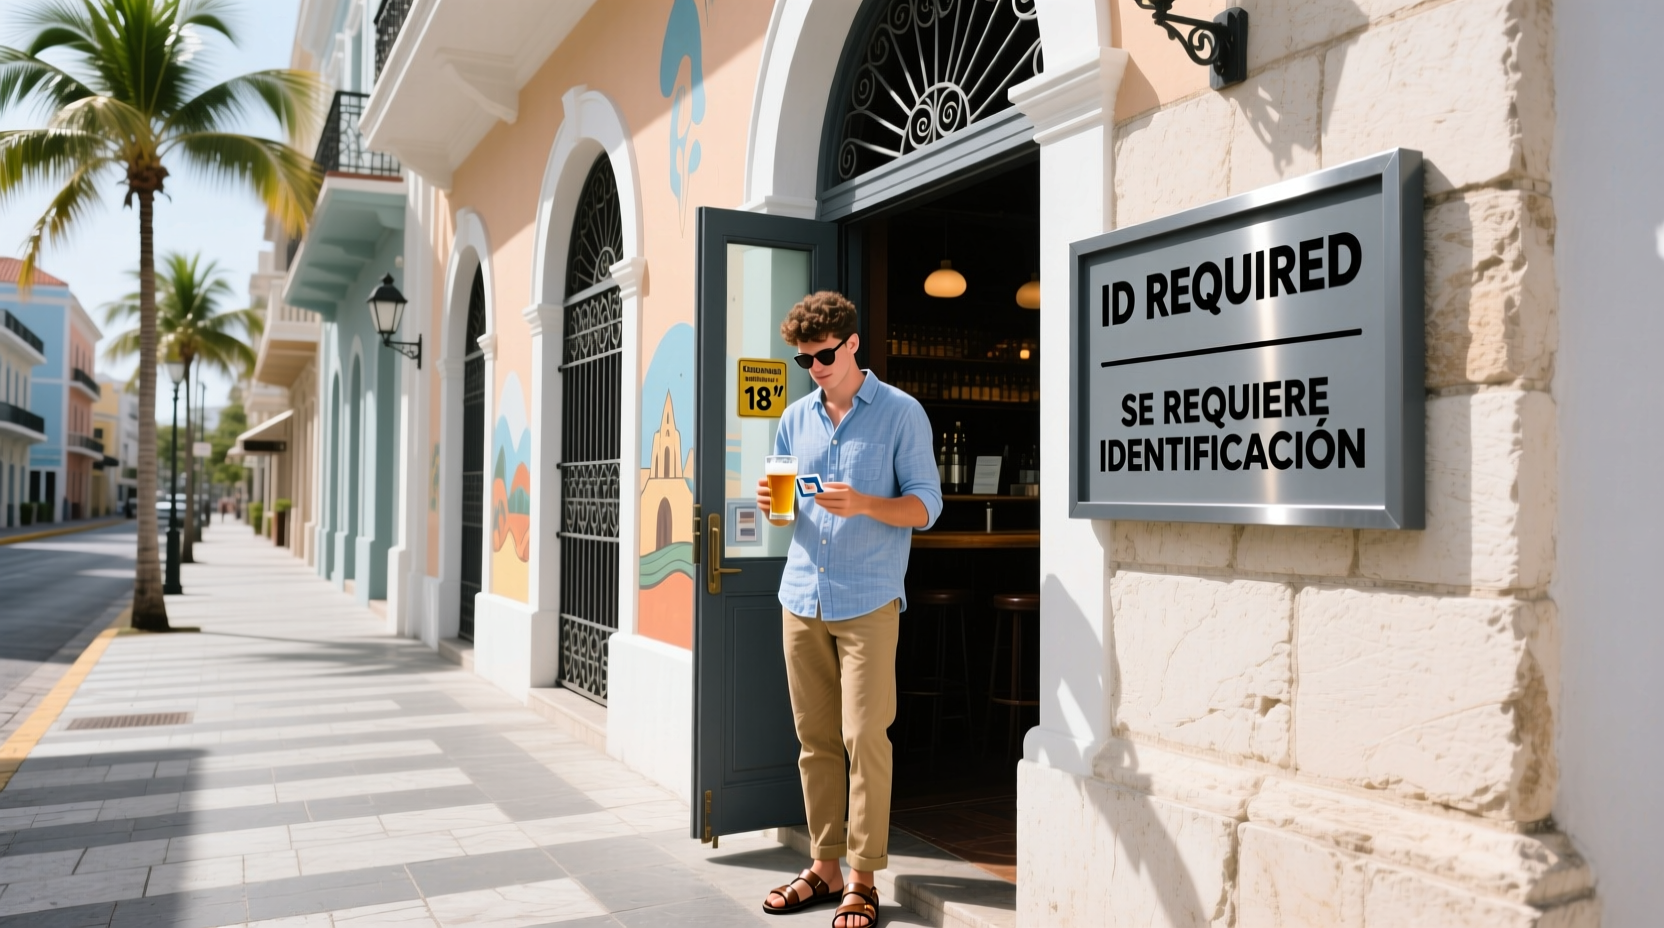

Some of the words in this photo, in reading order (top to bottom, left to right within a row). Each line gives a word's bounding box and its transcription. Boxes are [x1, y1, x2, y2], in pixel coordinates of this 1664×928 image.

[1101, 280, 1135, 328] ID
[1146, 231, 1363, 320] REQUIRED
[1121, 392, 1154, 428] SE
[1163, 376, 1330, 429] REQUIERE
[1100, 417, 1366, 472] IDENTIFICACIÓN
